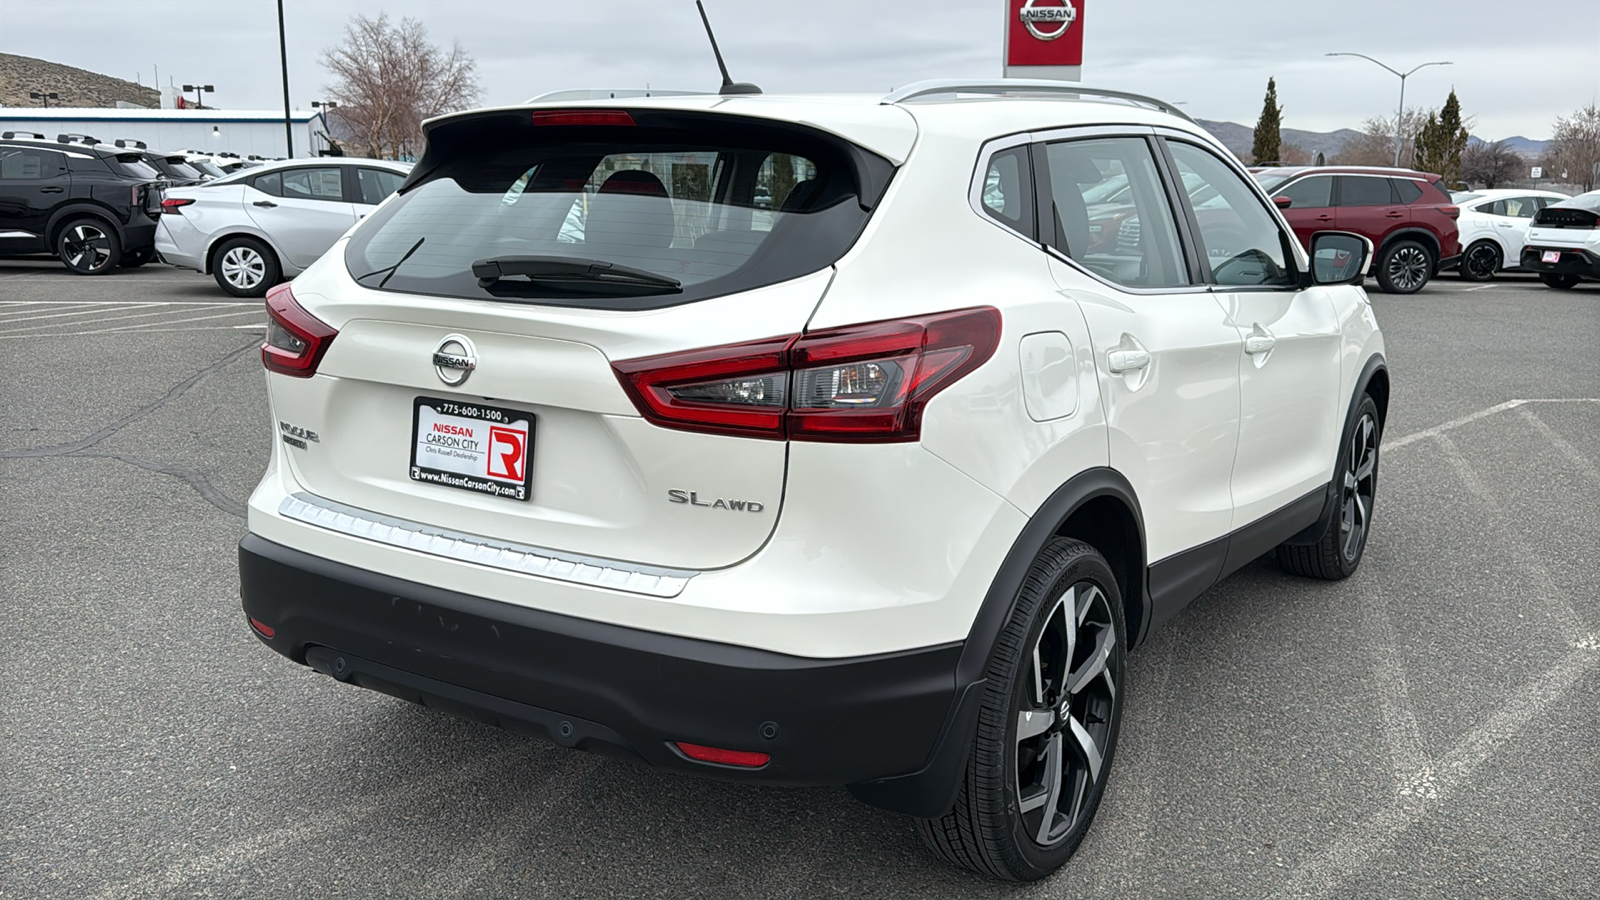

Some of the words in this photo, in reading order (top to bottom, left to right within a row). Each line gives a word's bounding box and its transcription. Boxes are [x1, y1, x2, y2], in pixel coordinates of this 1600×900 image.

[1026, 9, 1071, 18] NISSAN
[433, 354, 469, 367] NISSAN
[443, 403, 501, 420] 775-600-1500
[433, 423, 473, 438] NISSAN
[426, 433, 460, 448] CARSON
[461, 441, 479, 450] CITY
[453, 451, 478, 462] Dealership
[420, 471, 515, 496] www.NissanCarsonCity.com
[668, 489, 711, 507] SL
[712, 499, 764, 512] AWD
